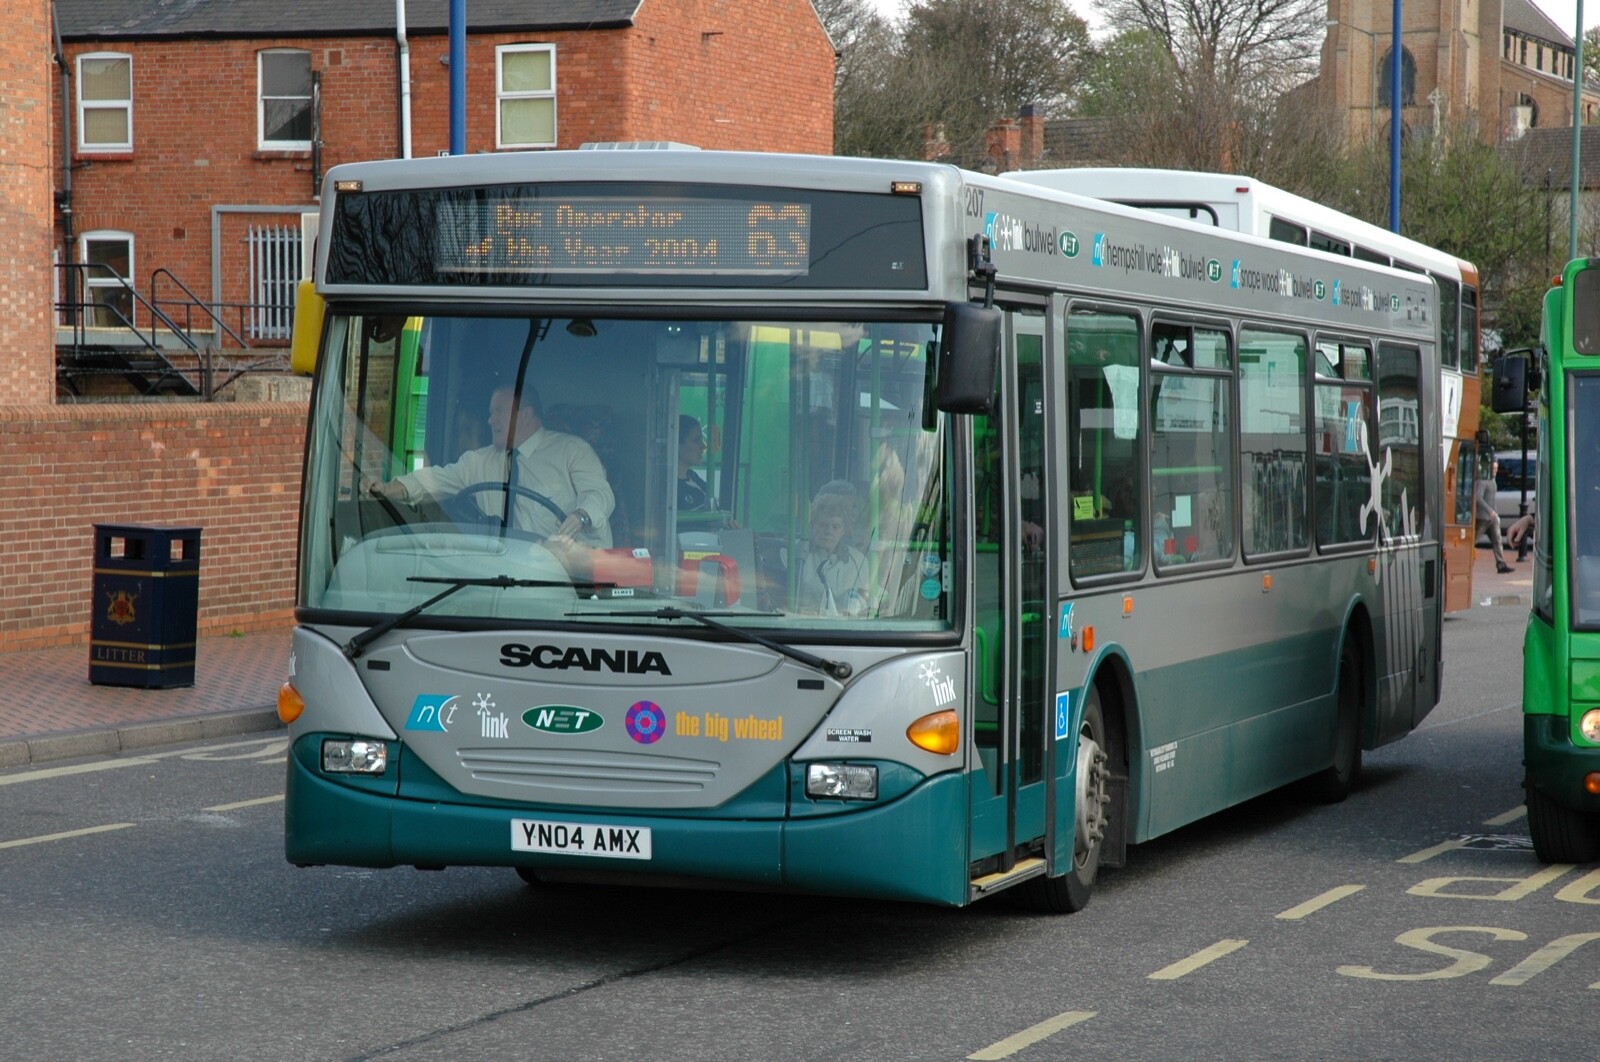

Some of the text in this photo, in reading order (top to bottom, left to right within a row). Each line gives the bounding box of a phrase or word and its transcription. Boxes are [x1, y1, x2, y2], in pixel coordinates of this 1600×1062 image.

[966, 187, 984, 218] 207
[496, 204, 685, 234] Bus Operator
[748, 204, 808, 266] 63
[1024, 221, 1058, 256] bulwell
[565, 238, 629, 265] Year
[644, 239, 717, 265] 2004
[1107, 238, 1145, 275] hempshill
[1146, 247, 1162, 275] vale
[1181, 251, 1206, 282] bulwell
[1261, 269, 1279, 293] wood
[1293, 274, 1313, 300] bulwell
[97, 647, 146, 663] LITTER
[499, 643, 673, 676] SCANIA
[930, 675, 957, 707] link
[481, 711, 509, 739] link
[535, 709, 590, 730] NET
[675, 711, 784, 743] the big wheel
[522, 822, 640, 853] YN04 AMX
